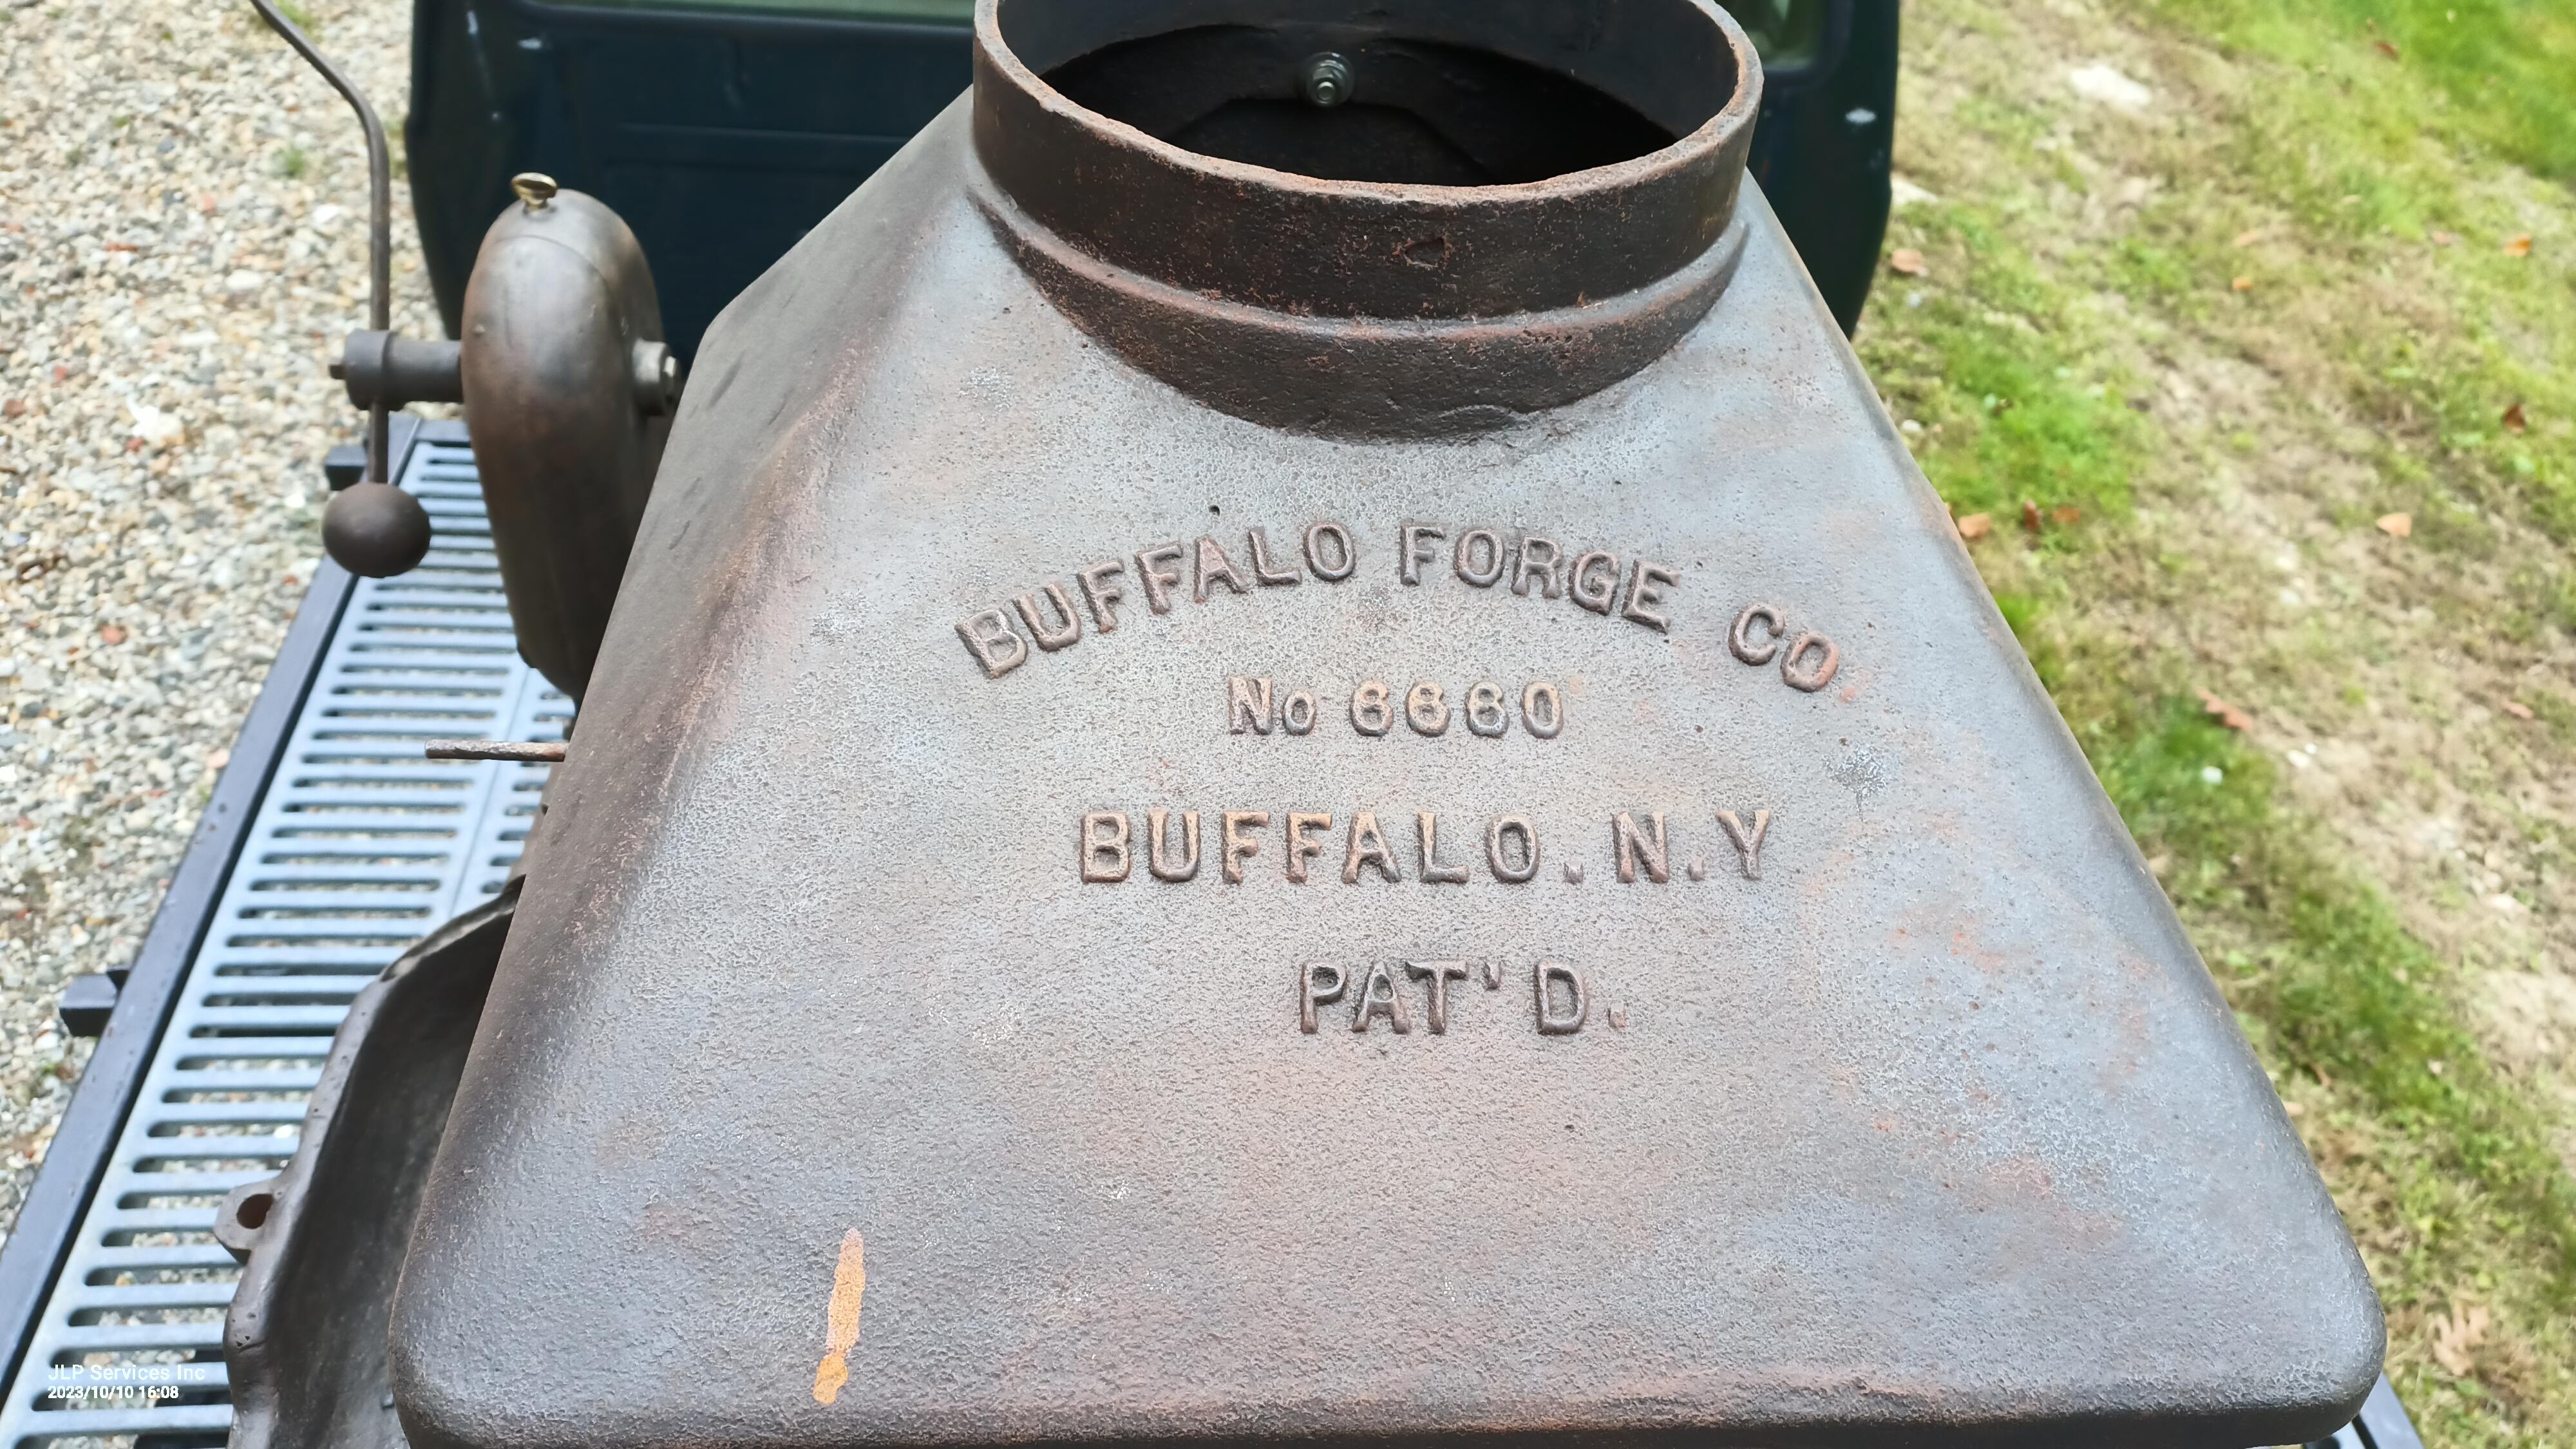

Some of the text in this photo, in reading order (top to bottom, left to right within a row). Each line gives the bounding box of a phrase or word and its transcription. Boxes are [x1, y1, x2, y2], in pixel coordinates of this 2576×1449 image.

[955, 520, 1356, 679] BUFFALO
[1399, 524, 1679, 634] FORGE
[1229, 677, 1317, 736] No
